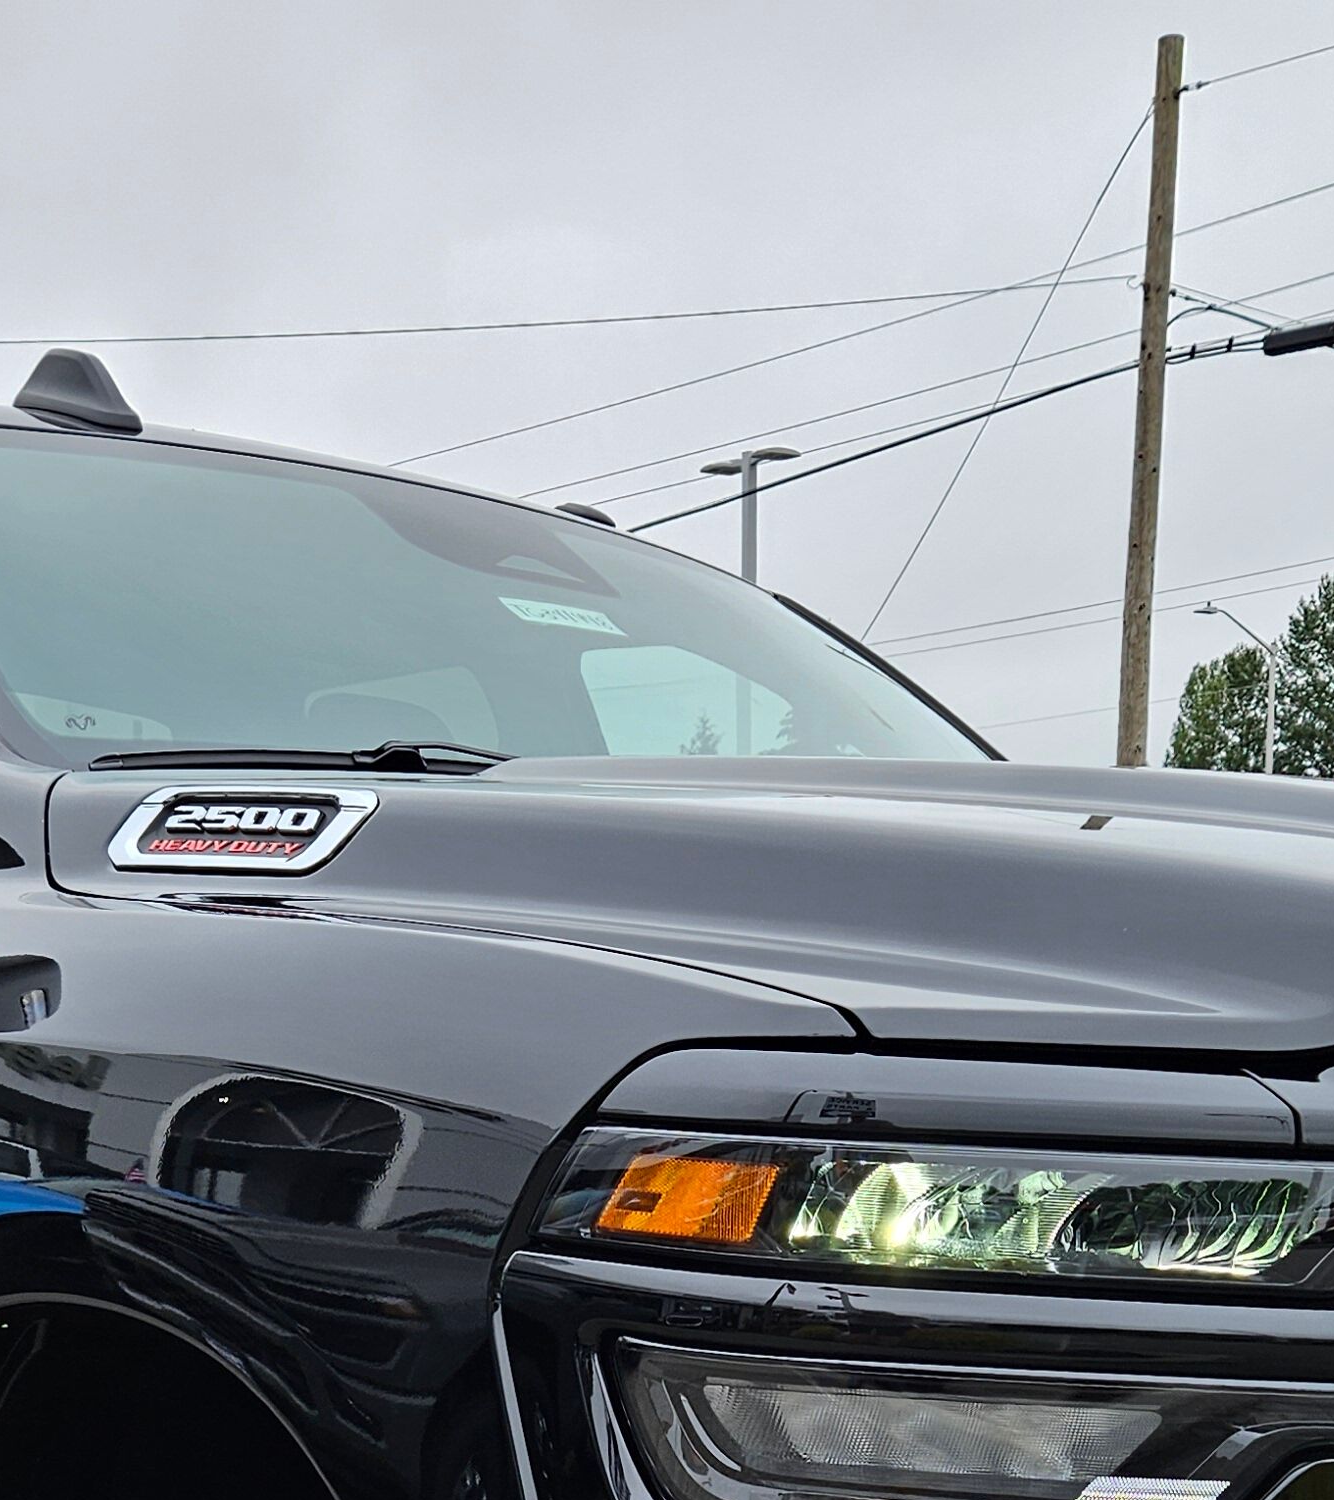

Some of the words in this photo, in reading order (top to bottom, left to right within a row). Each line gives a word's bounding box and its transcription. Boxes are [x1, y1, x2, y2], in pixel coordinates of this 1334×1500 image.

[165, 805, 322, 833] 2500
[149, 839, 228, 853] HEAVY
[229, 840, 303, 855] DUTY
